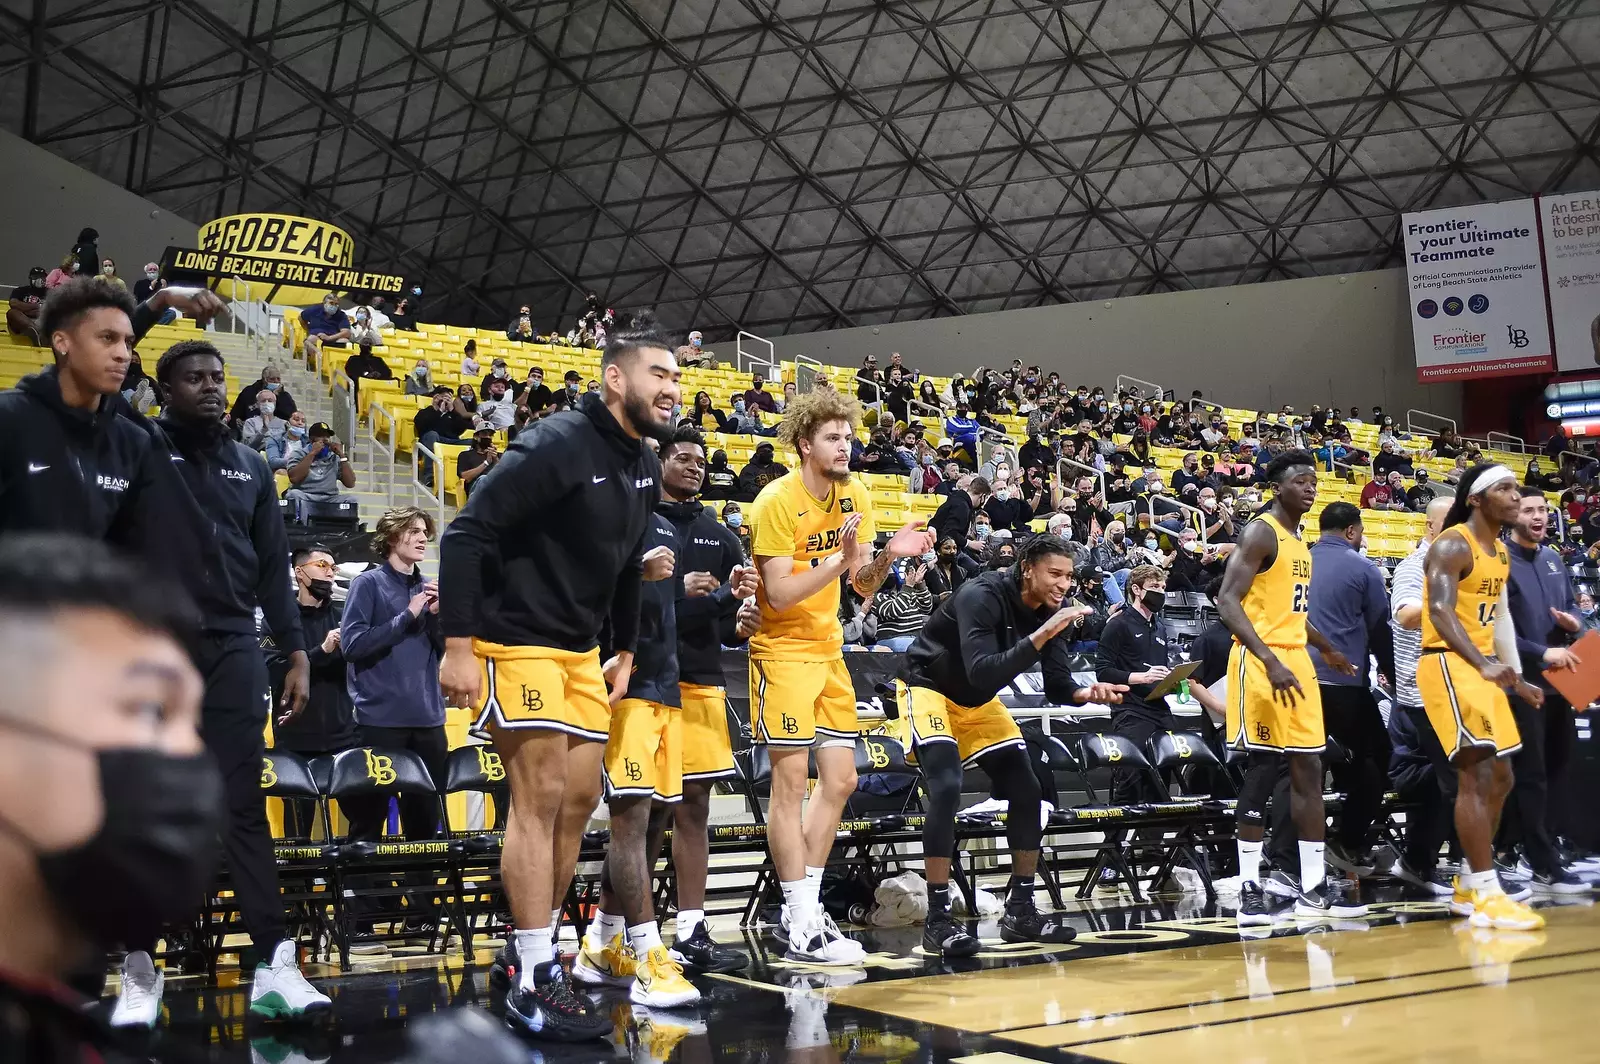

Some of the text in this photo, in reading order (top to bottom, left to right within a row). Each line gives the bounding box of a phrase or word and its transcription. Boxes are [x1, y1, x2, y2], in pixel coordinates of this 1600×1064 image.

[1551, 202, 1567, 214] An
[1570, 199, 1594, 212] E.R.
[1552, 215, 1560, 226] it
[1553, 225, 1600, 238] to be pr
[203, 217, 353, 267] #GOBEACH
[1420, 228, 1530, 250] your Ultimate
[1411, 247, 1495, 264] Teammate
[174, 251, 404, 292] LONG BEACH STATE ATHLETICS
[1412, 264, 1537, 282] Official Communications Provider
[1572, 274, 1594, 282] Dignity
[1413, 273, 1523, 290] of Long Beach State Athletics
[1433, 332, 1486, 346] Frontier
[1434, 342, 1485, 351] COMMUNICATIONS
[1422, 359, 1548, 377] frontier.com/UltimateTeammate
[221, 468, 252, 481] BEACH
[97, 475, 130, 489] BEACH
[635, 477, 654, 489] EACH
[694, 537, 720, 547] BEACH
[805, 533, 818, 553] THE
[1476, 577, 1489, 595] THE
[261, 757, 278, 788] B
[1076, 810, 1091, 819] LONG
[1109, 808, 1124, 817] STATE
[836, 821, 871, 831] EACH STATE
[905, 816, 920, 826] LONG
[715, 825, 768, 836] LONG BEACH STA
[274, 848, 322, 859] EACH STATE
[377, 842, 449, 855] LONG BEACH STATE
